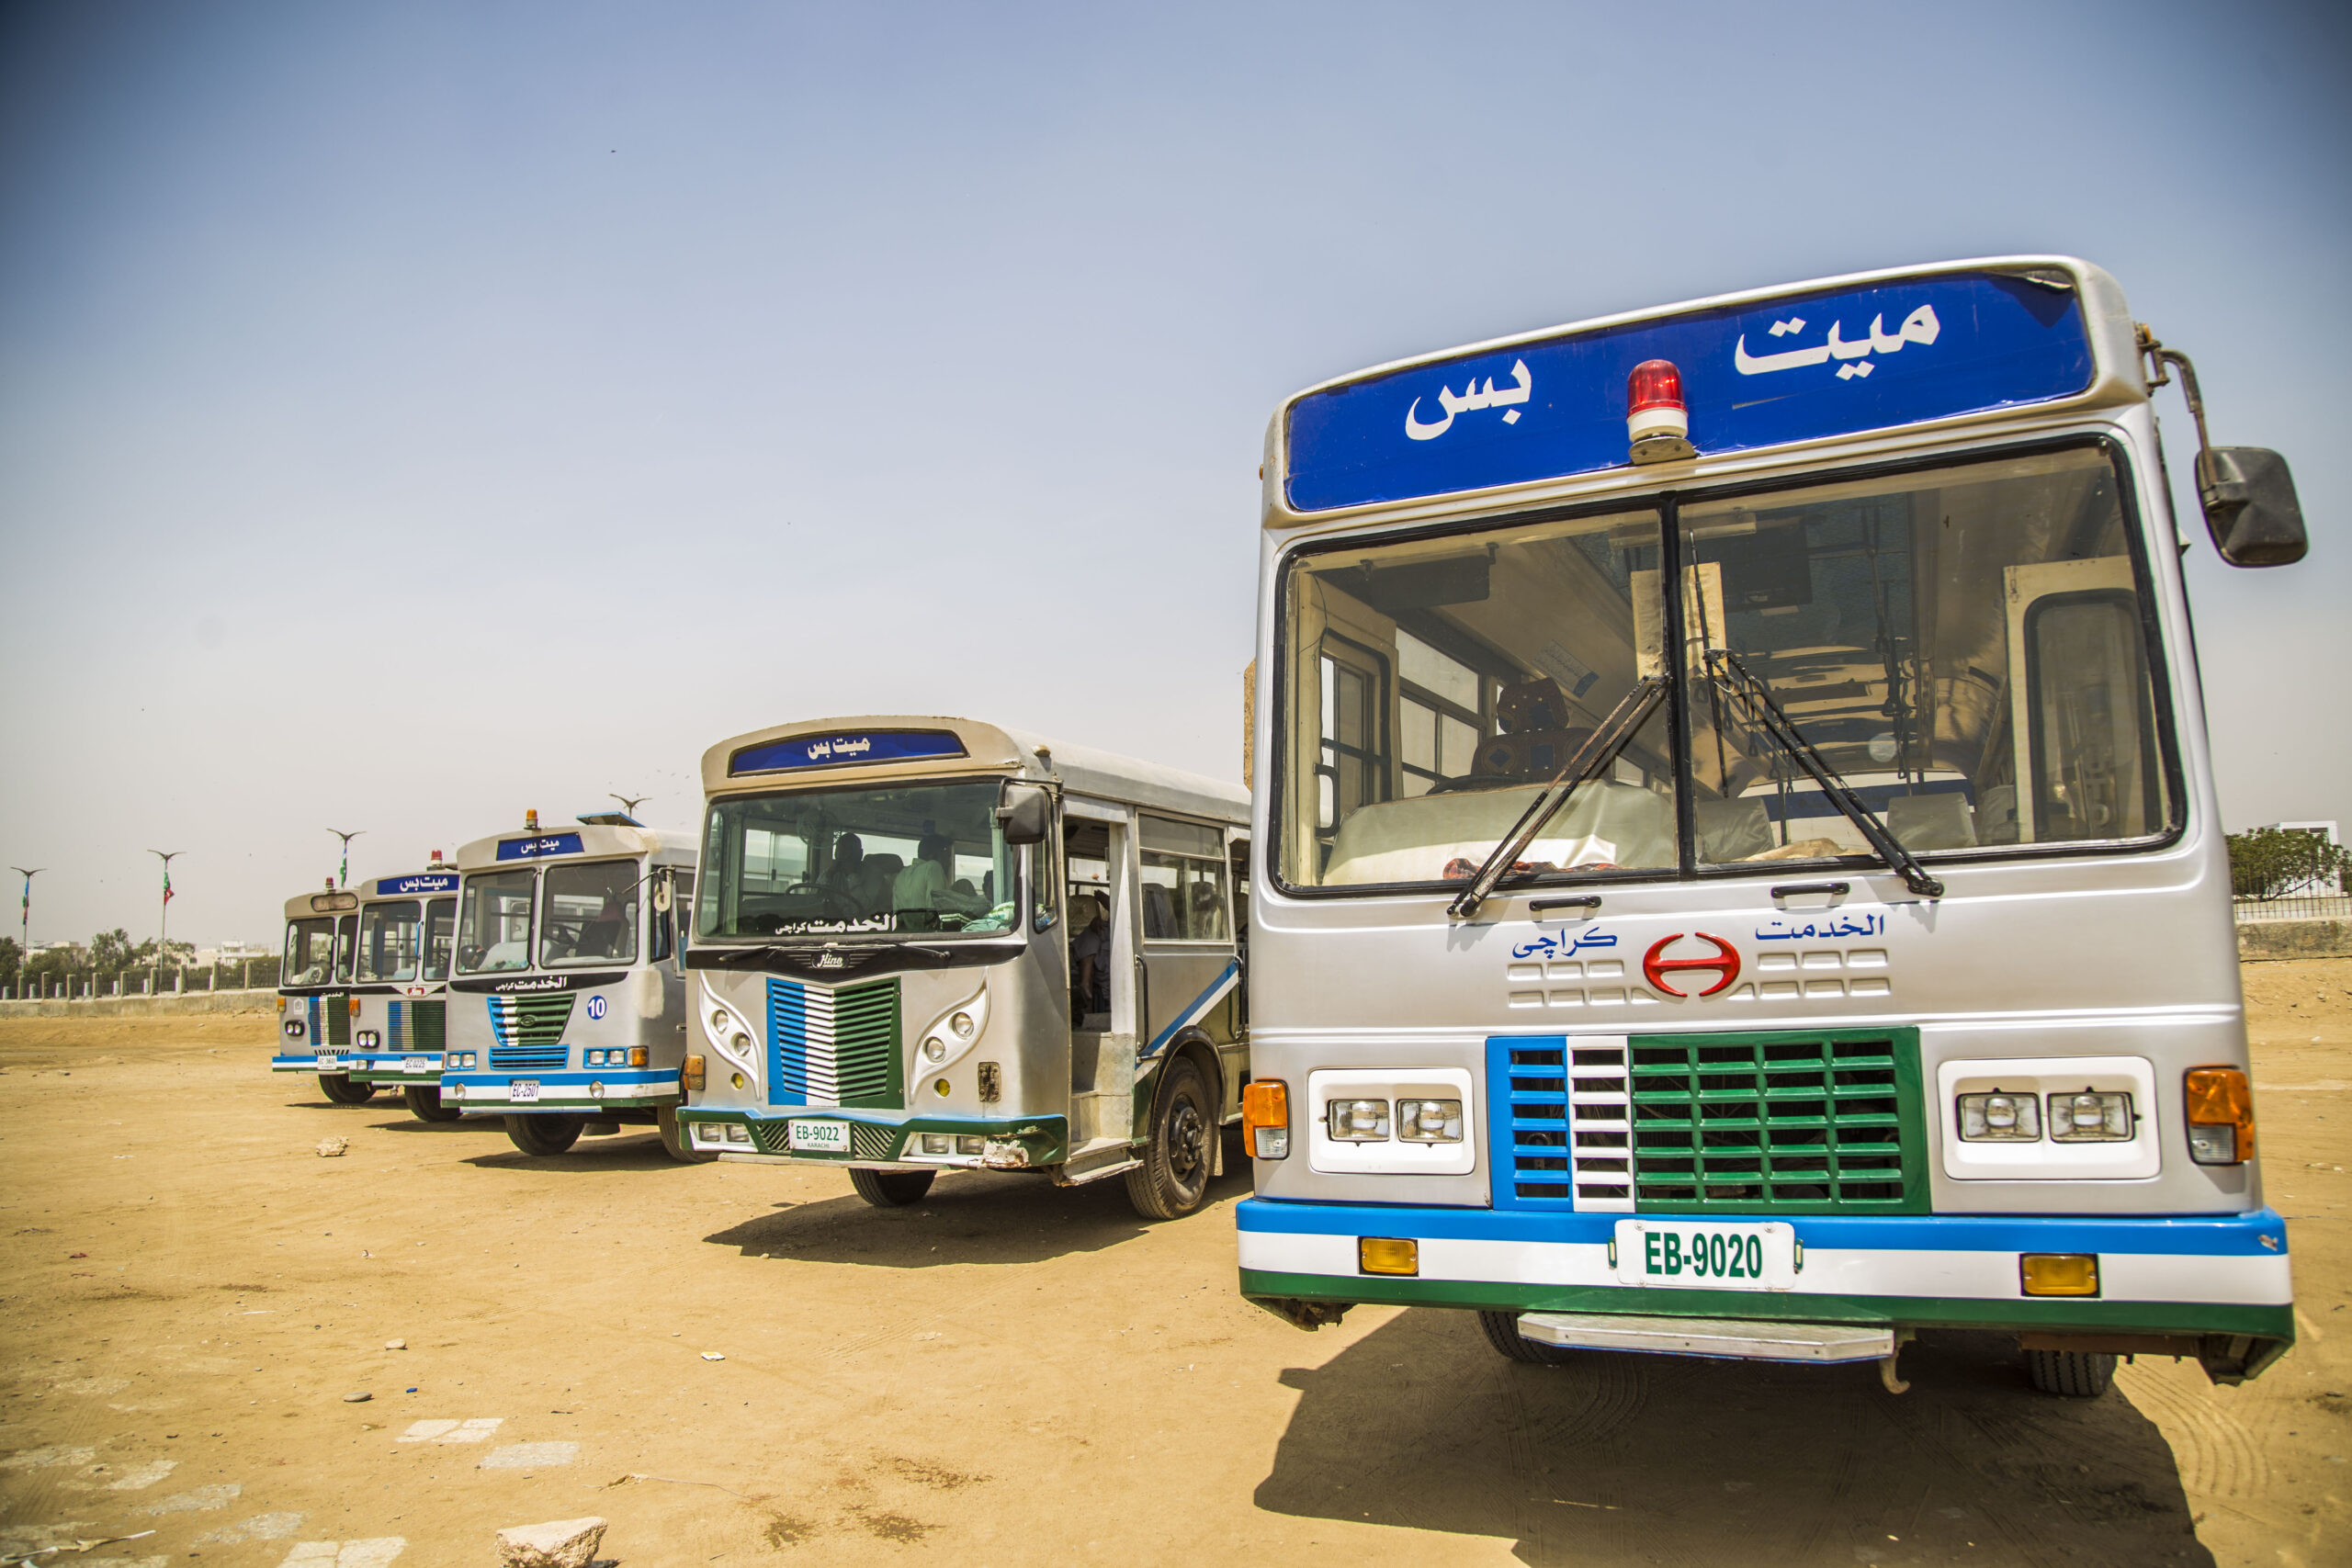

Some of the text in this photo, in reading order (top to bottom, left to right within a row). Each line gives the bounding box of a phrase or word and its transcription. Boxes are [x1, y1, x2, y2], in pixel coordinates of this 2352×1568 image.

[1405, 303, 1940, 440] میت بس
[808, 738, 870, 760] میت بس
[521, 841, 537, 854] بس
[400, 877, 419, 892] بس
[807, 913, 897, 932] الخدمت
[1756, 914, 1883, 942] الخدمت
[817, 953, 843, 968] Hino
[514, 976, 568, 989] الخدمت
[588, 998, 605, 1018] 10
[796, 1125, 840, 1141] EB-9022
[1645, 1232, 1762, 1279] EB-9020
